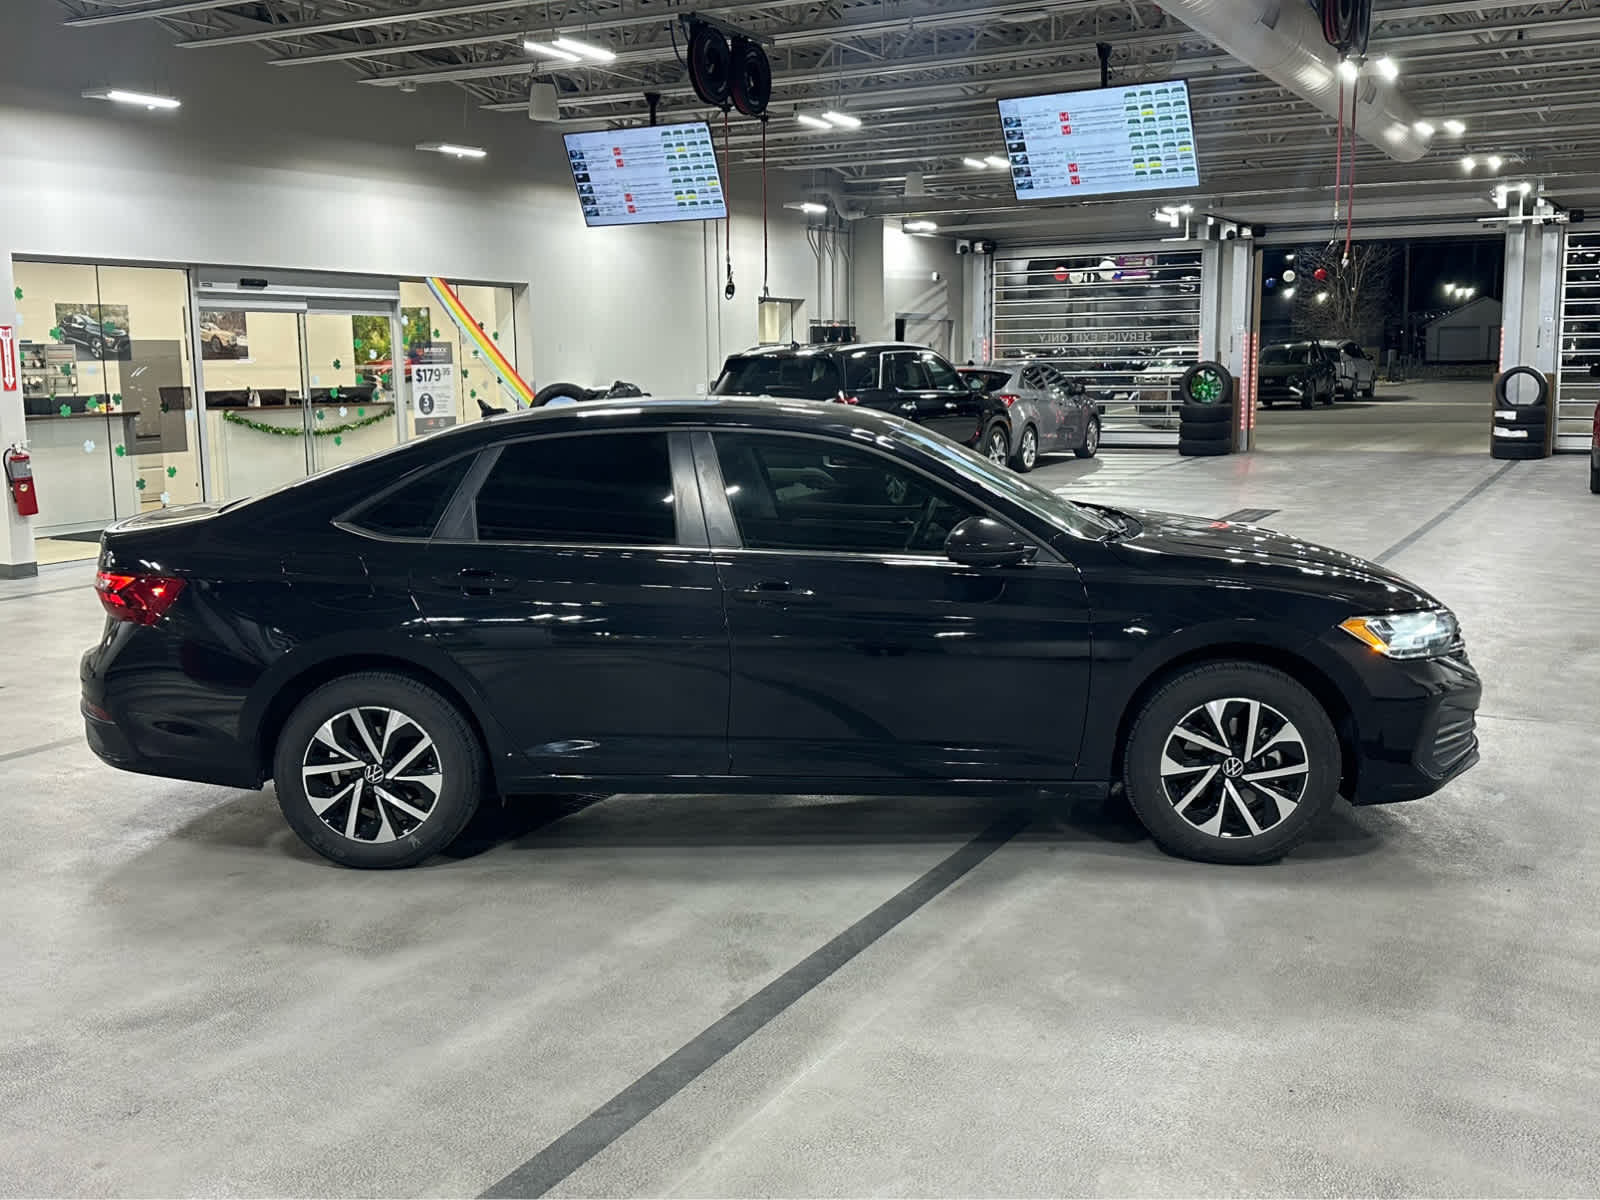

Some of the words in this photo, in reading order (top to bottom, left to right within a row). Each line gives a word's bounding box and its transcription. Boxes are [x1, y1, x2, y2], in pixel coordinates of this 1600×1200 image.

[415, 368, 441, 383] $179
[423, 395, 430, 407] 3
[364, 764, 384, 784] VW
[1223, 757, 1244, 777] VW
